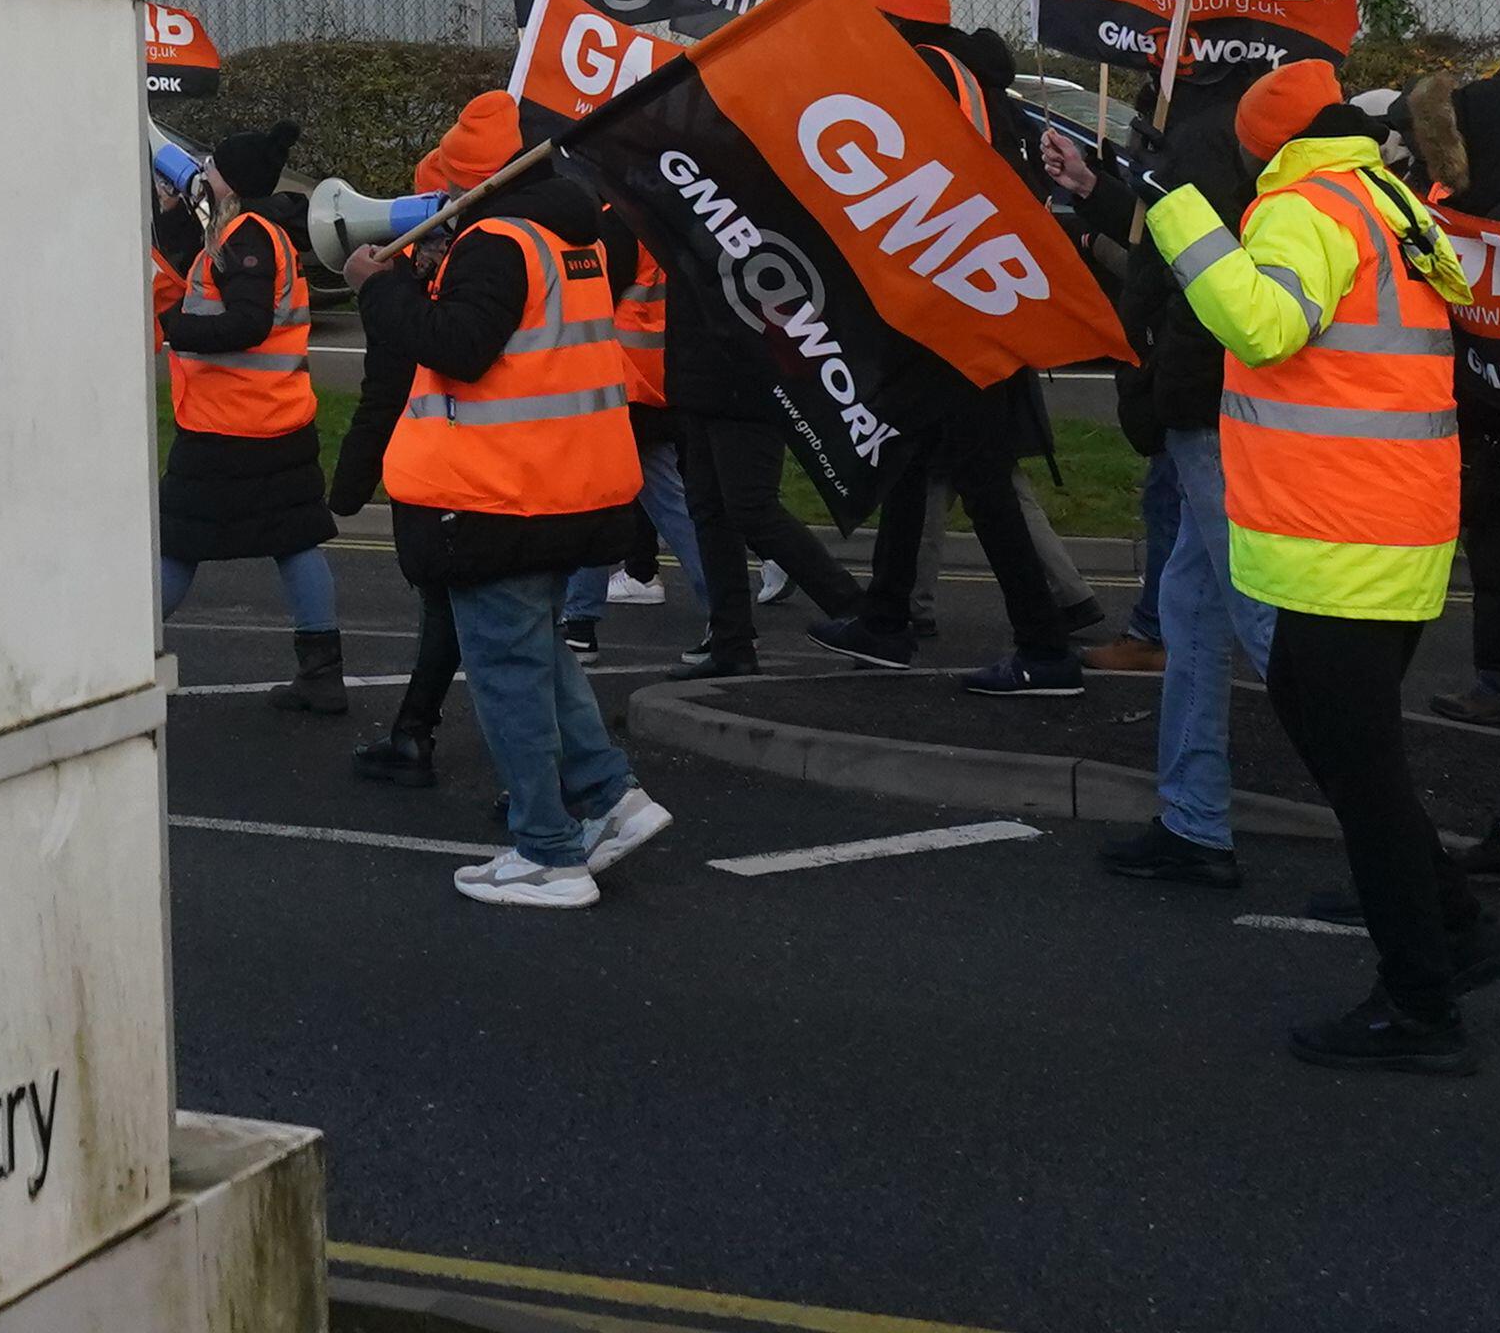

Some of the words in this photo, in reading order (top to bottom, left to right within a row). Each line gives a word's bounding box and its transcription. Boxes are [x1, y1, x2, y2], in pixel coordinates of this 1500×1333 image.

[659, 150, 901, 468] GMB@WORK
[797, 93, 1051, 317] GMB
[772, 384, 850, 498] www.gmb.org.uk
